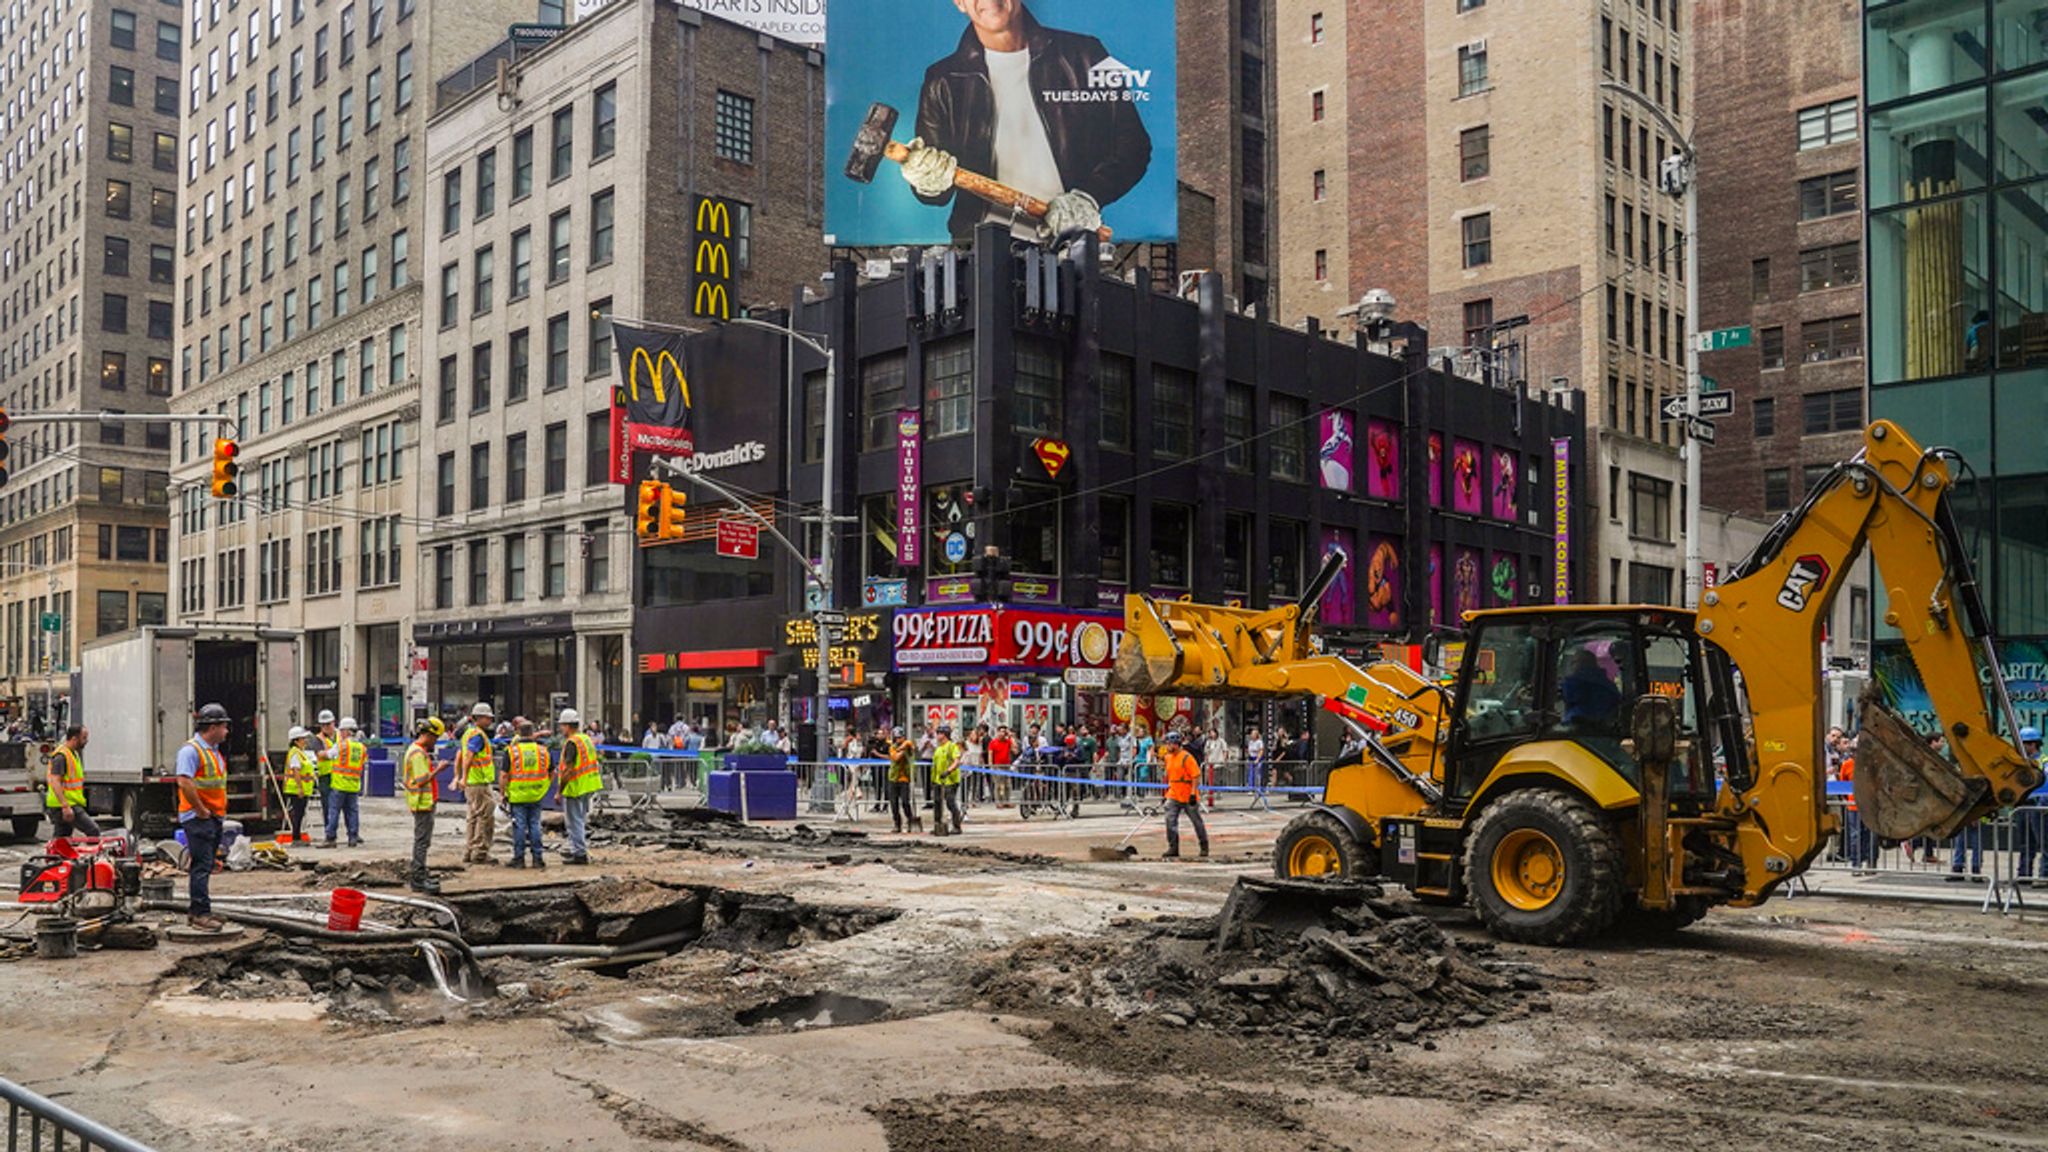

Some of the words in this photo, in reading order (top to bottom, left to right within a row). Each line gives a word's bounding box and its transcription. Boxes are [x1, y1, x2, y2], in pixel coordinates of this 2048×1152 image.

[743, 20, 825, 34] OLAPLEX.CO
[1087, 69, 1151, 88] HGTV
[1042, 90, 1118, 102] TUESDAYS
[1720, 331, 1728, 347] 7
[619, 415, 630, 480] McDonald's
[668, 440, 766, 477] McDonald's
[901, 439, 917, 502] MIDTOWN
[1555, 458, 1568, 535] MIDTOWN
[902, 507, 916, 562] COMICS
[949, 542, 964, 556] DC
[1555, 540, 1568, 599] COMICS
[1778, 561, 1820, 612] CAT
[785, 613, 880, 646] SMR'S
[935, 613, 994, 644] PIZZA
[802, 645, 861, 669] WRLD
[1394, 707, 1418, 728] 450
